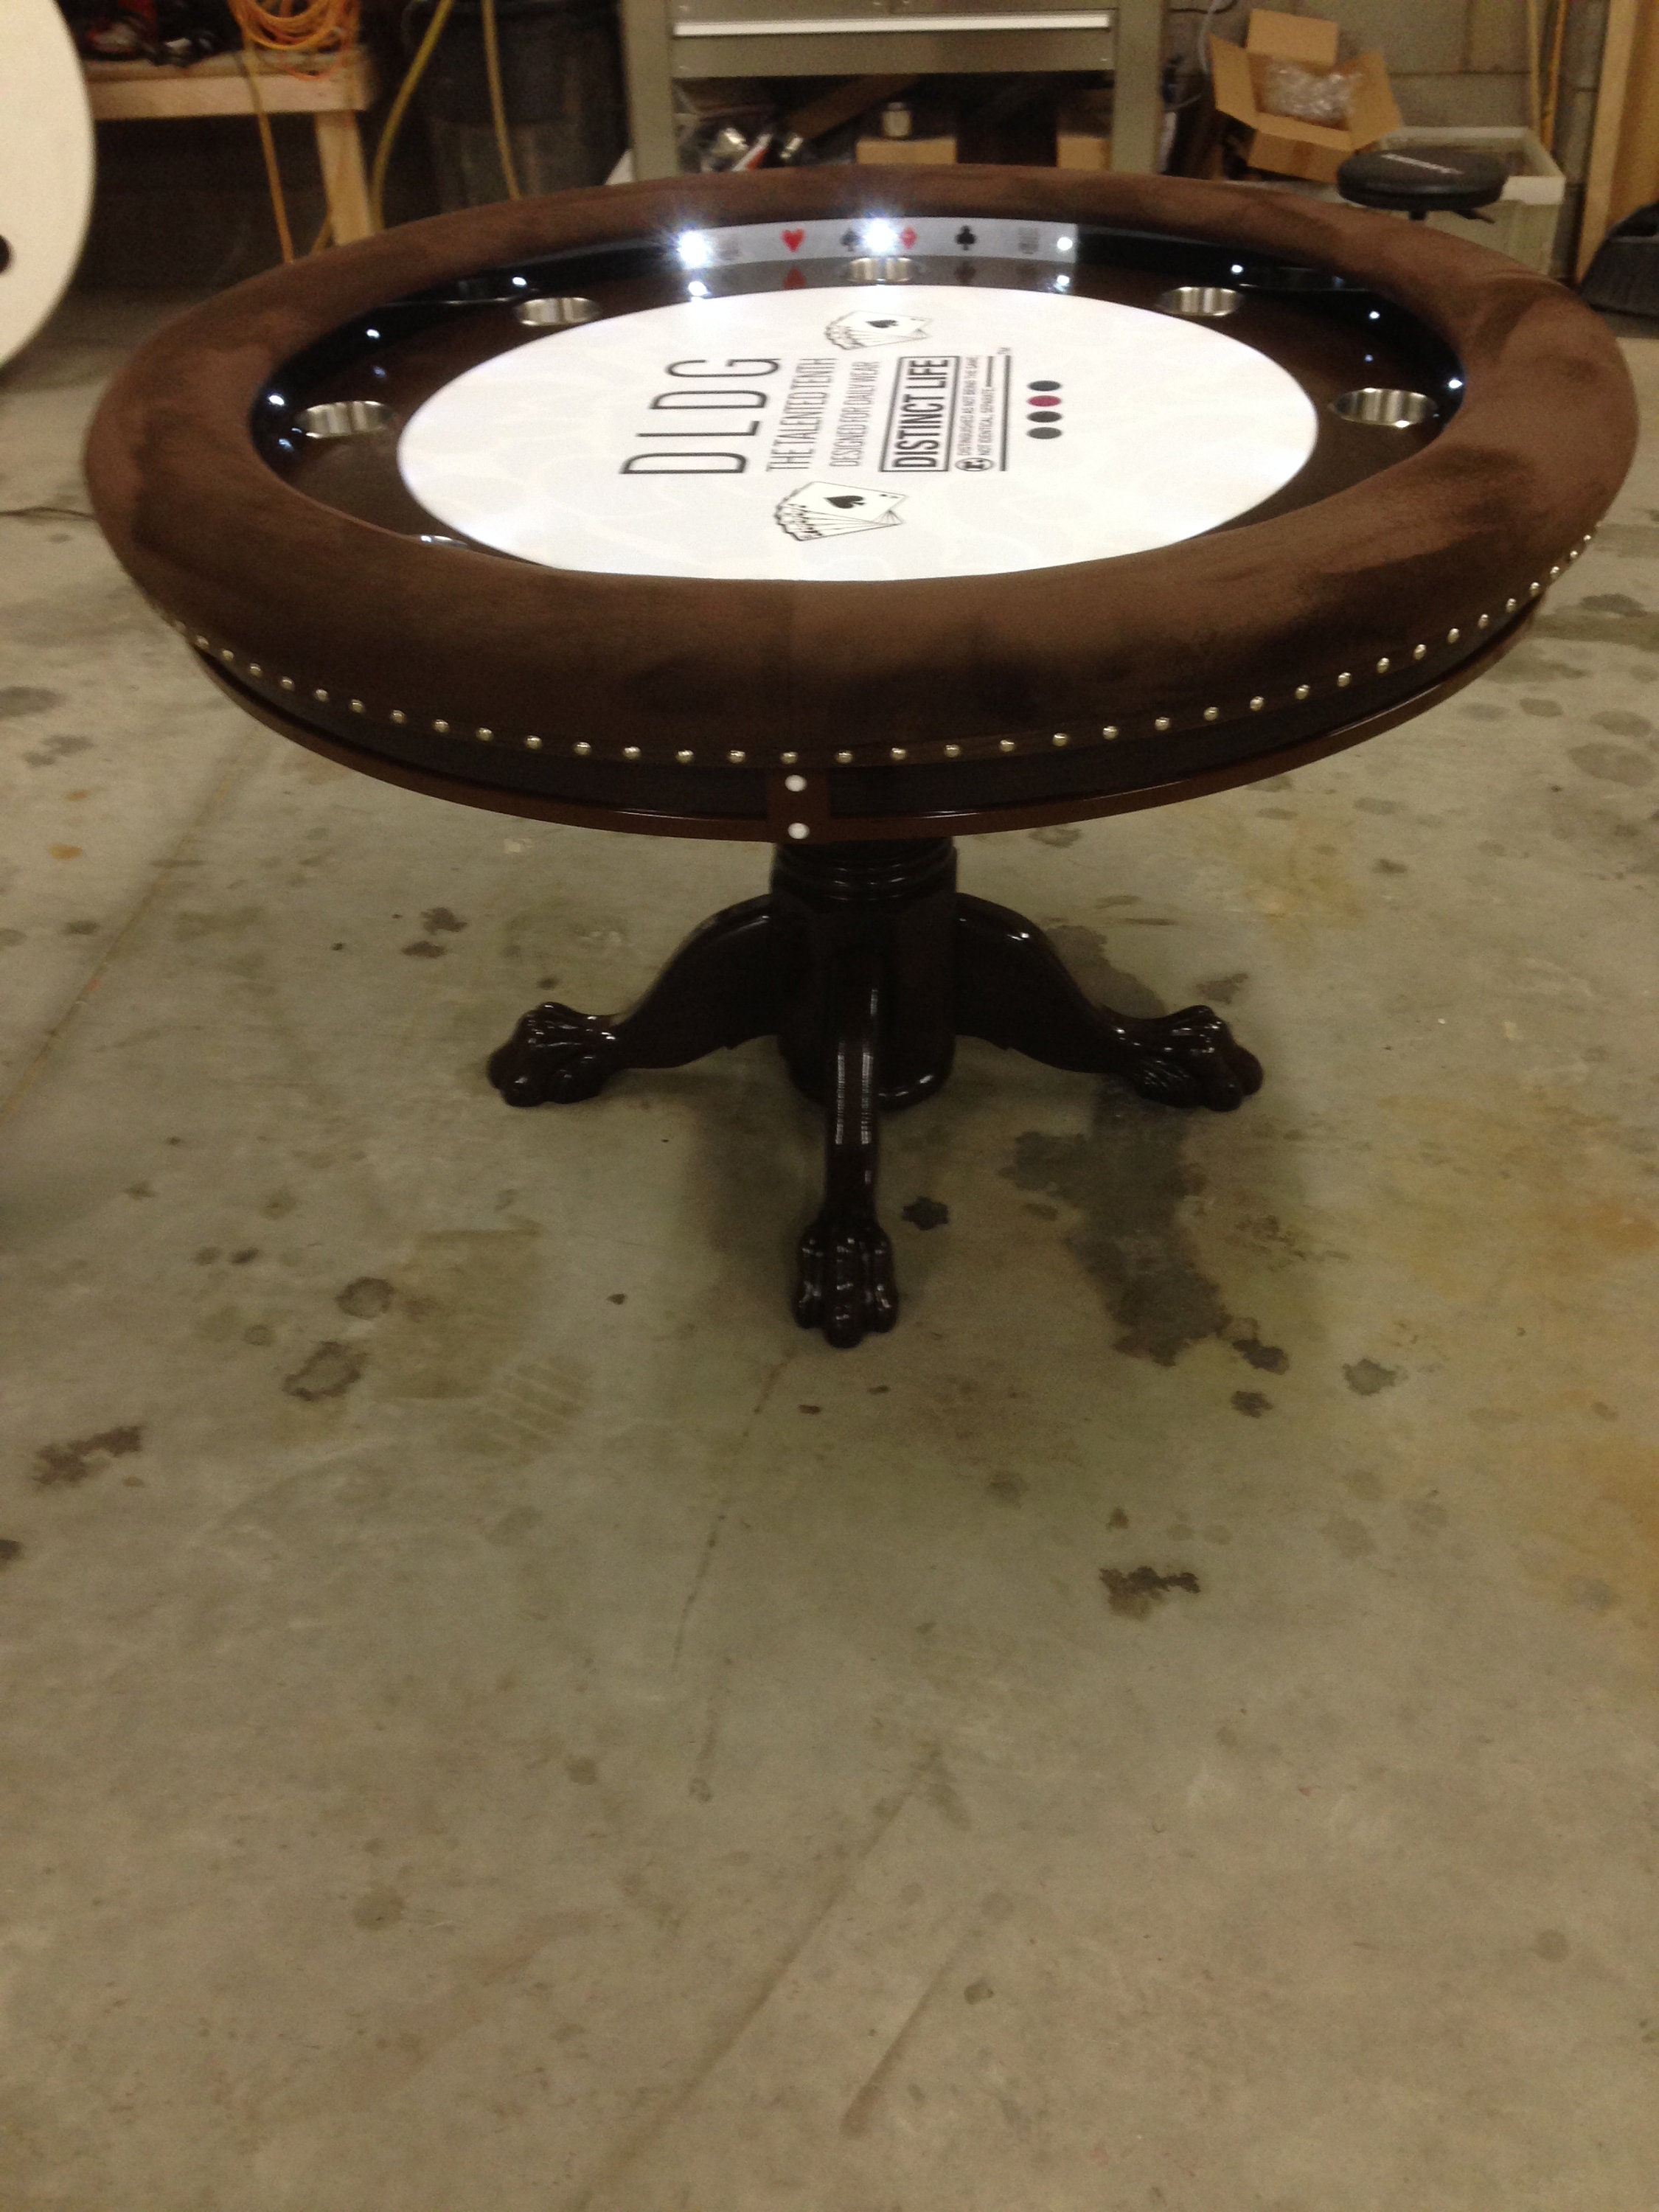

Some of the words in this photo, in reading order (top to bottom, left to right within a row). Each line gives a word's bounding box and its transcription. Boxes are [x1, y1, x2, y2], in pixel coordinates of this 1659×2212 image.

[790, 358, 838, 389] TENTH
[849, 361, 880, 383] WEAR
[905, 359, 948, 389] LIFE
[843, 384, 875, 406] DAILY
[619, 358, 781, 474] DLDG
[773, 392, 829, 446] TALENTED
[839, 406, 872, 422] FOR
[830, 424, 868, 467] DESIGNED
[892, 394, 945, 467] DISTINCT
[767, 448, 815, 472] THE
